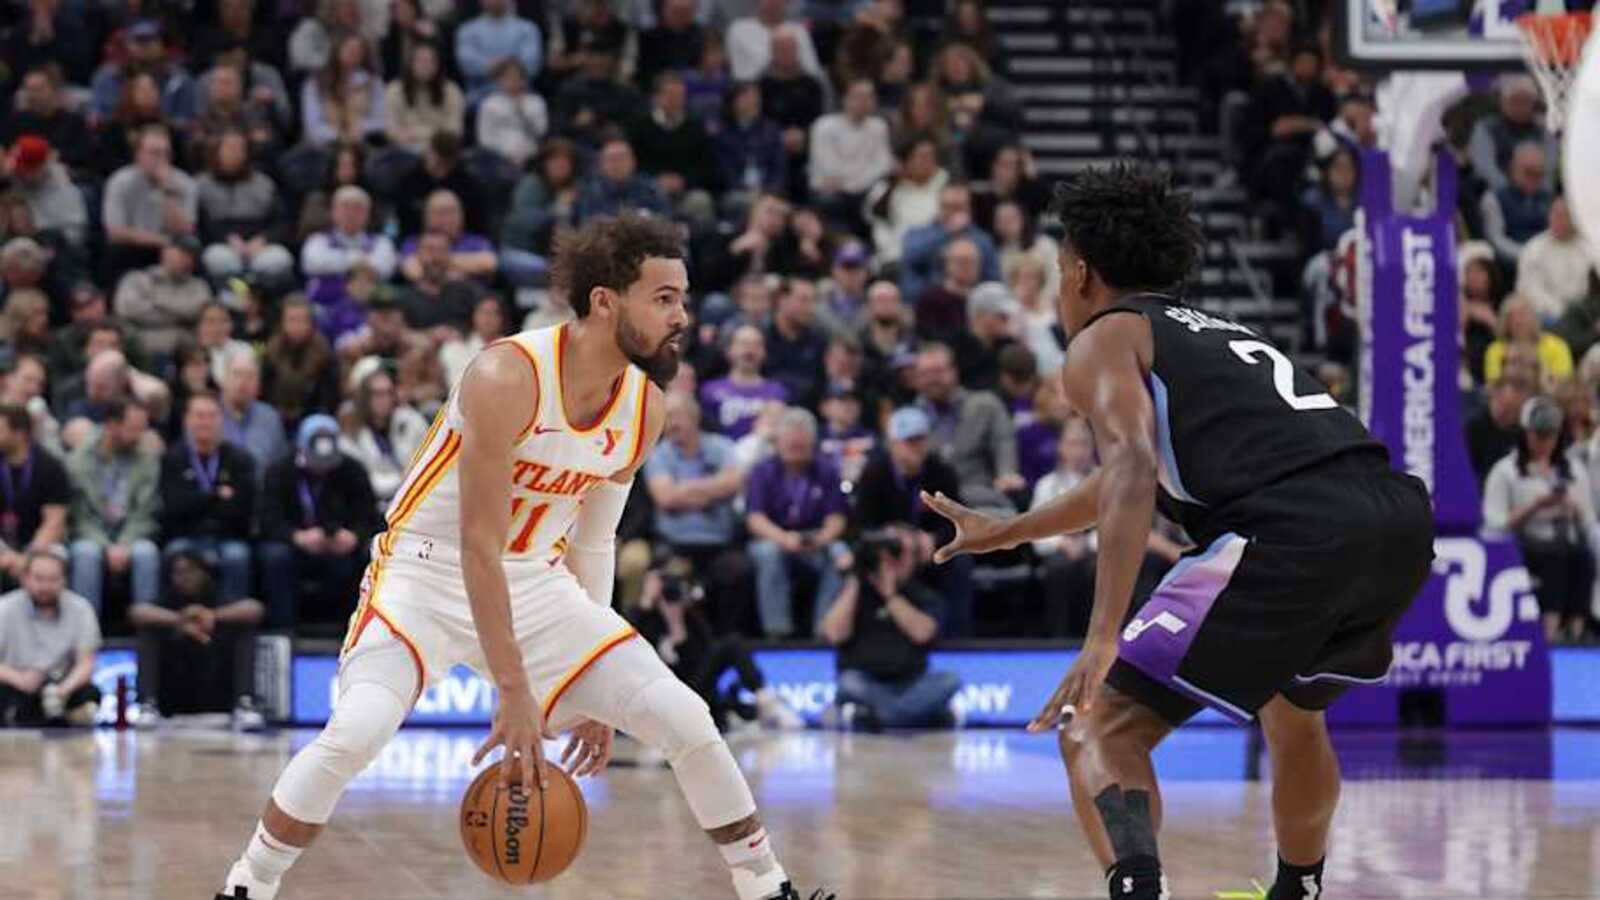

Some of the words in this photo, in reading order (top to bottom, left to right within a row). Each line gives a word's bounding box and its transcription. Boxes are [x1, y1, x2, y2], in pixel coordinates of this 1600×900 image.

[1403, 227, 1435, 338] FIRST
[1228, 339, 1338, 410] 2
[1403, 340, 1435, 508] MERICA
[1444, 640, 1533, 671] FIRST
